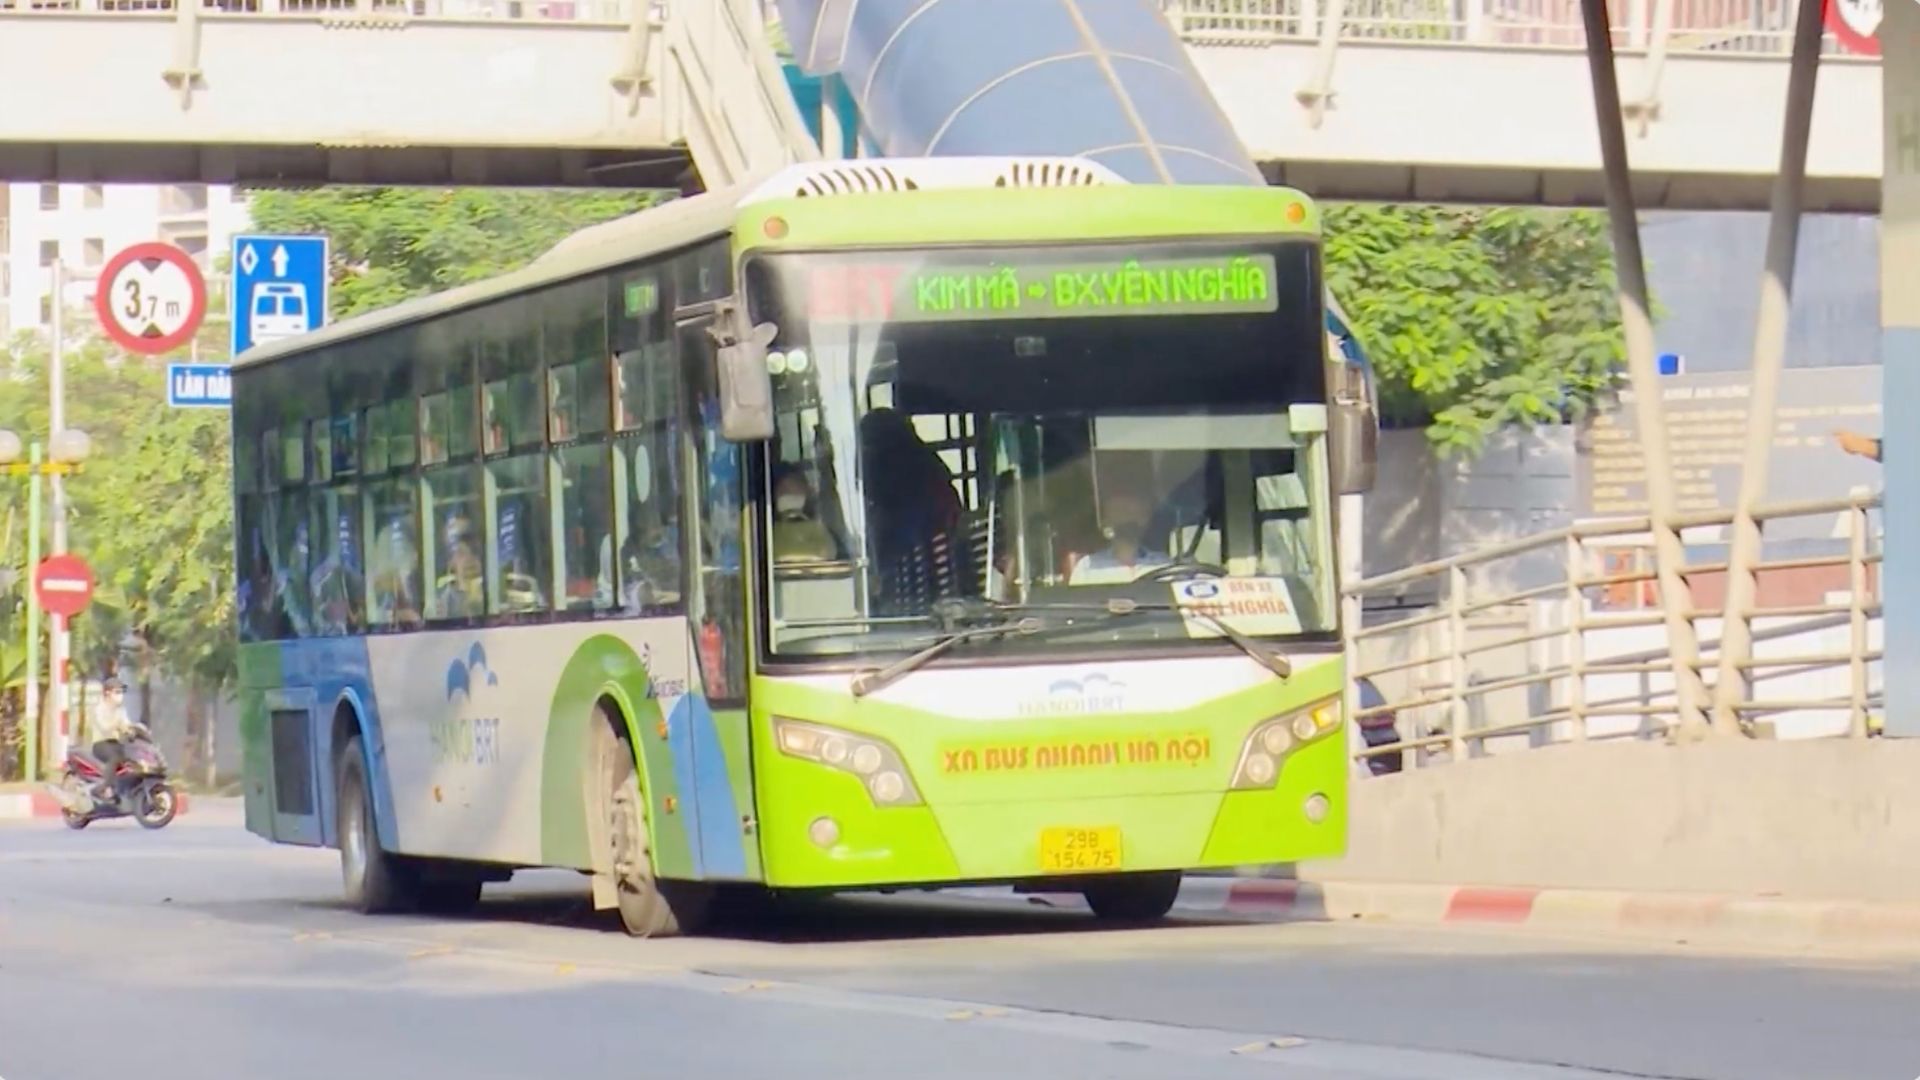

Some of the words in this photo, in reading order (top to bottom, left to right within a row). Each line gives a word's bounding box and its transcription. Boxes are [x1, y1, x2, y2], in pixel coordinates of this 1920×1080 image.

[125, 279, 158, 322] 3,7
[166, 301, 180, 317] m
[917, 275, 971, 311] KIM
[976, 266, 1020, 310] MÃ
[1171, 256, 1267, 302] NGHĨA
[175, 369, 205, 399] LÀN
[985, 747, 1029, 770] BUS
[1036, 742, 1120, 768] NHANH
[1166, 731, 1211, 768] NỘI
[1065, 829, 1099, 849] 29B
